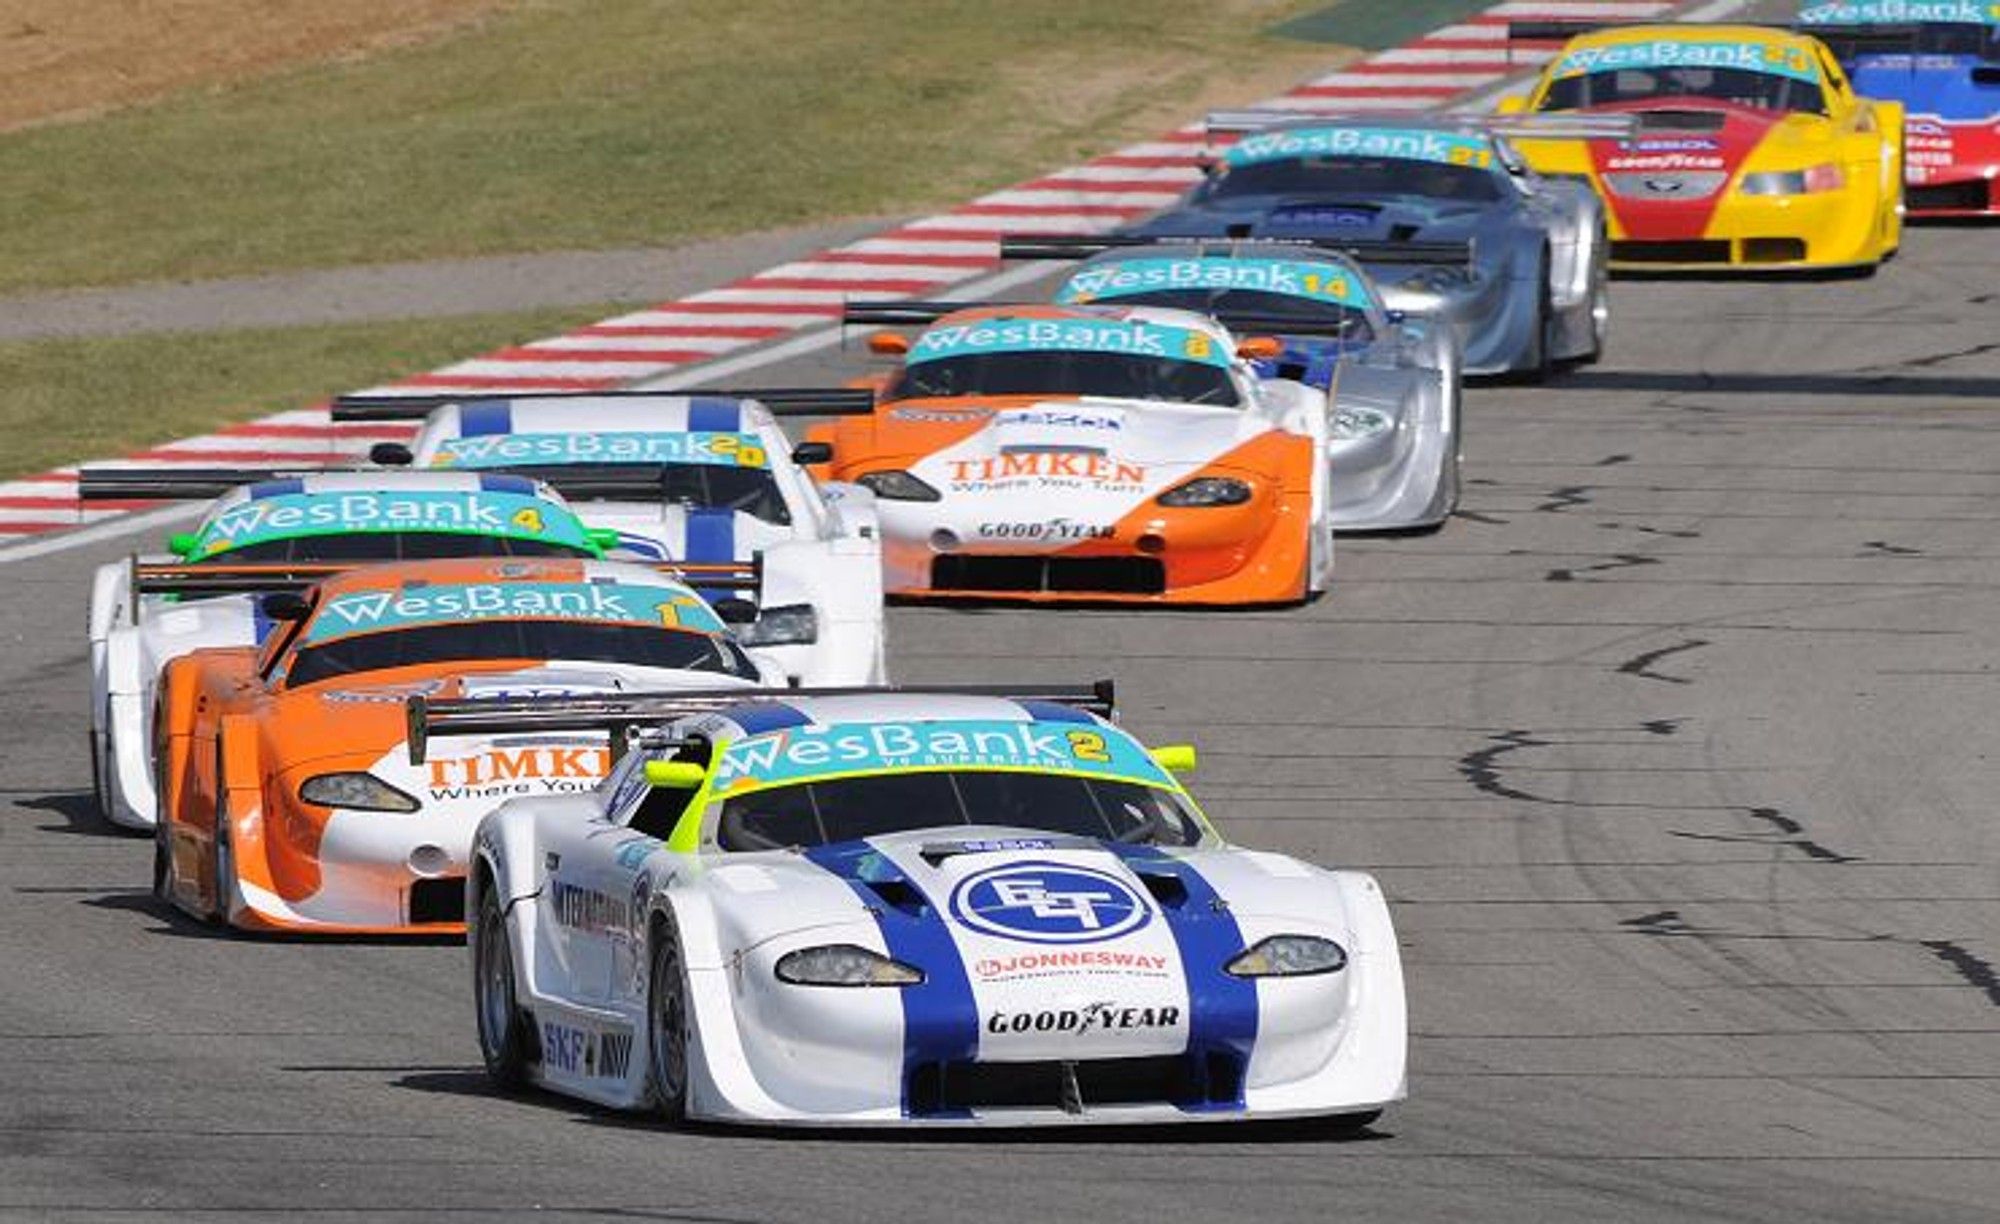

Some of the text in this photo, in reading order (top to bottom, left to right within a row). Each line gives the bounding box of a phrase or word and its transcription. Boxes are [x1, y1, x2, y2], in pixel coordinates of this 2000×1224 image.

[1570, 42, 1765, 68] WesBank
[1241, 129, 1446, 159] WesBank
[1069, 263, 1297, 291] WesBank
[1302, 274, 1347, 298] 14
[922, 321, 1164, 350] WesBank
[446, 433, 767, 468] WesBank 20
[948, 453, 1148, 483] TIMKEN
[216, 494, 545, 538] WesBank 4
[330, 586, 680, 627] WesBank 1
[426, 749, 613, 788] TIMK
[725, 724, 1112, 778] WesBank 2
[430, 779, 599, 801] Where You
[1001, 951, 1168, 971] JONNESWAY
[545, 1023, 583, 1073] SKF
